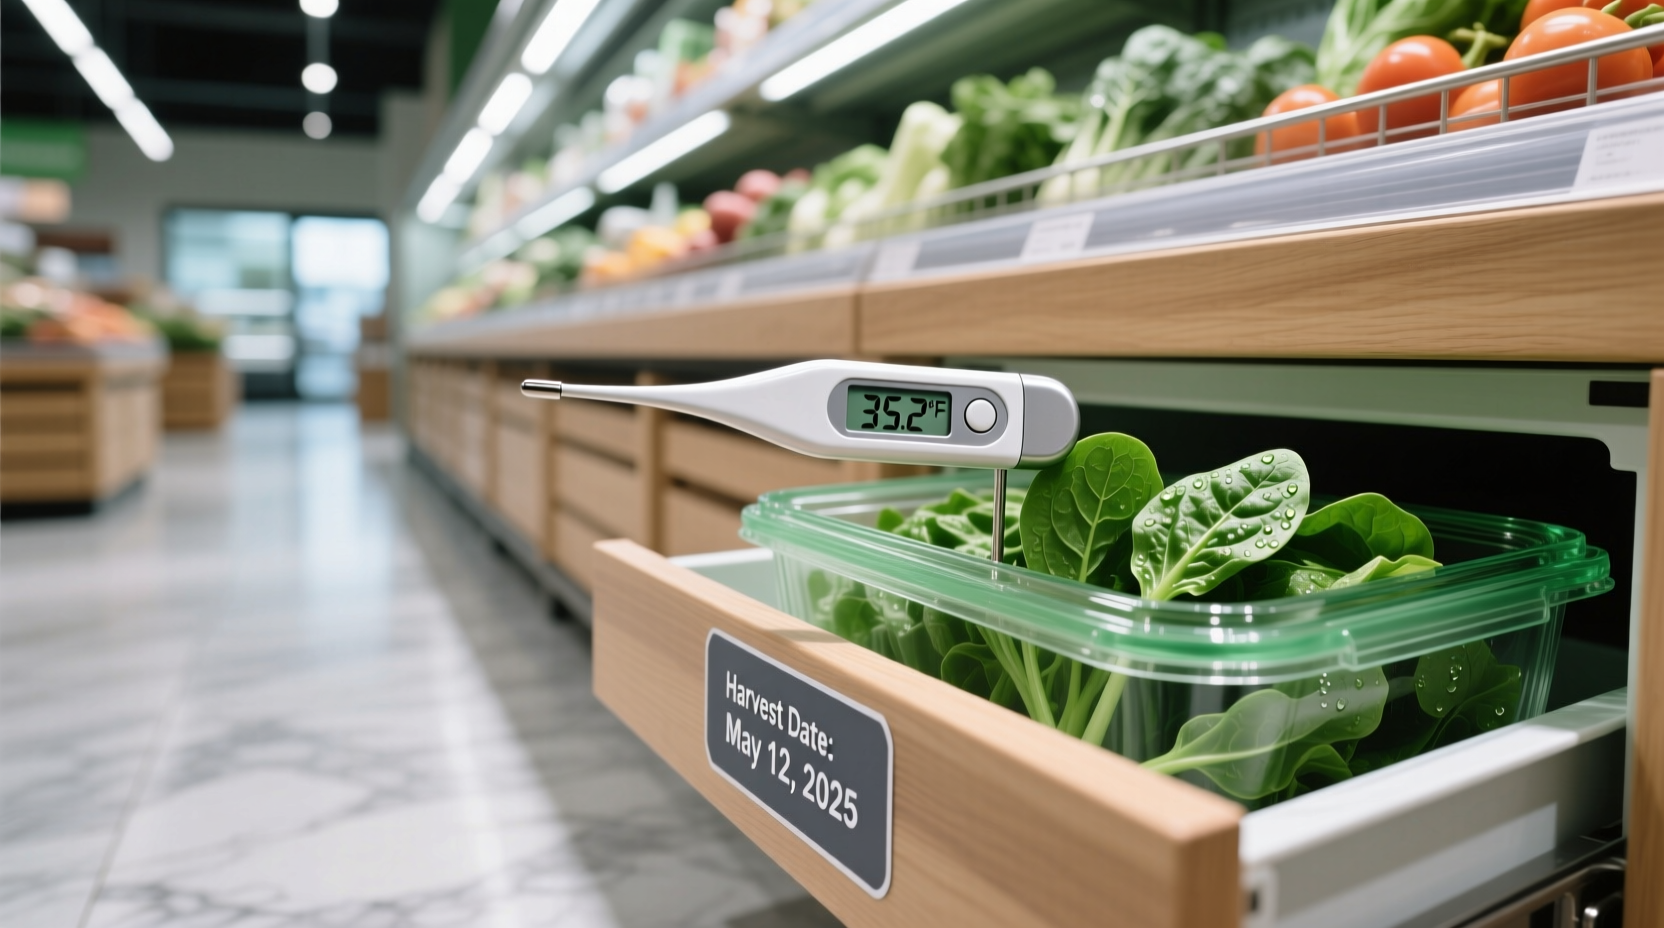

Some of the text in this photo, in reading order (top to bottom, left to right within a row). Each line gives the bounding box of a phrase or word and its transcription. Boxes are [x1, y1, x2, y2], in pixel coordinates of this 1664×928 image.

[726, 670, 834, 761] Harvest Date:
[725, 712, 858, 829] May 12, 2025
